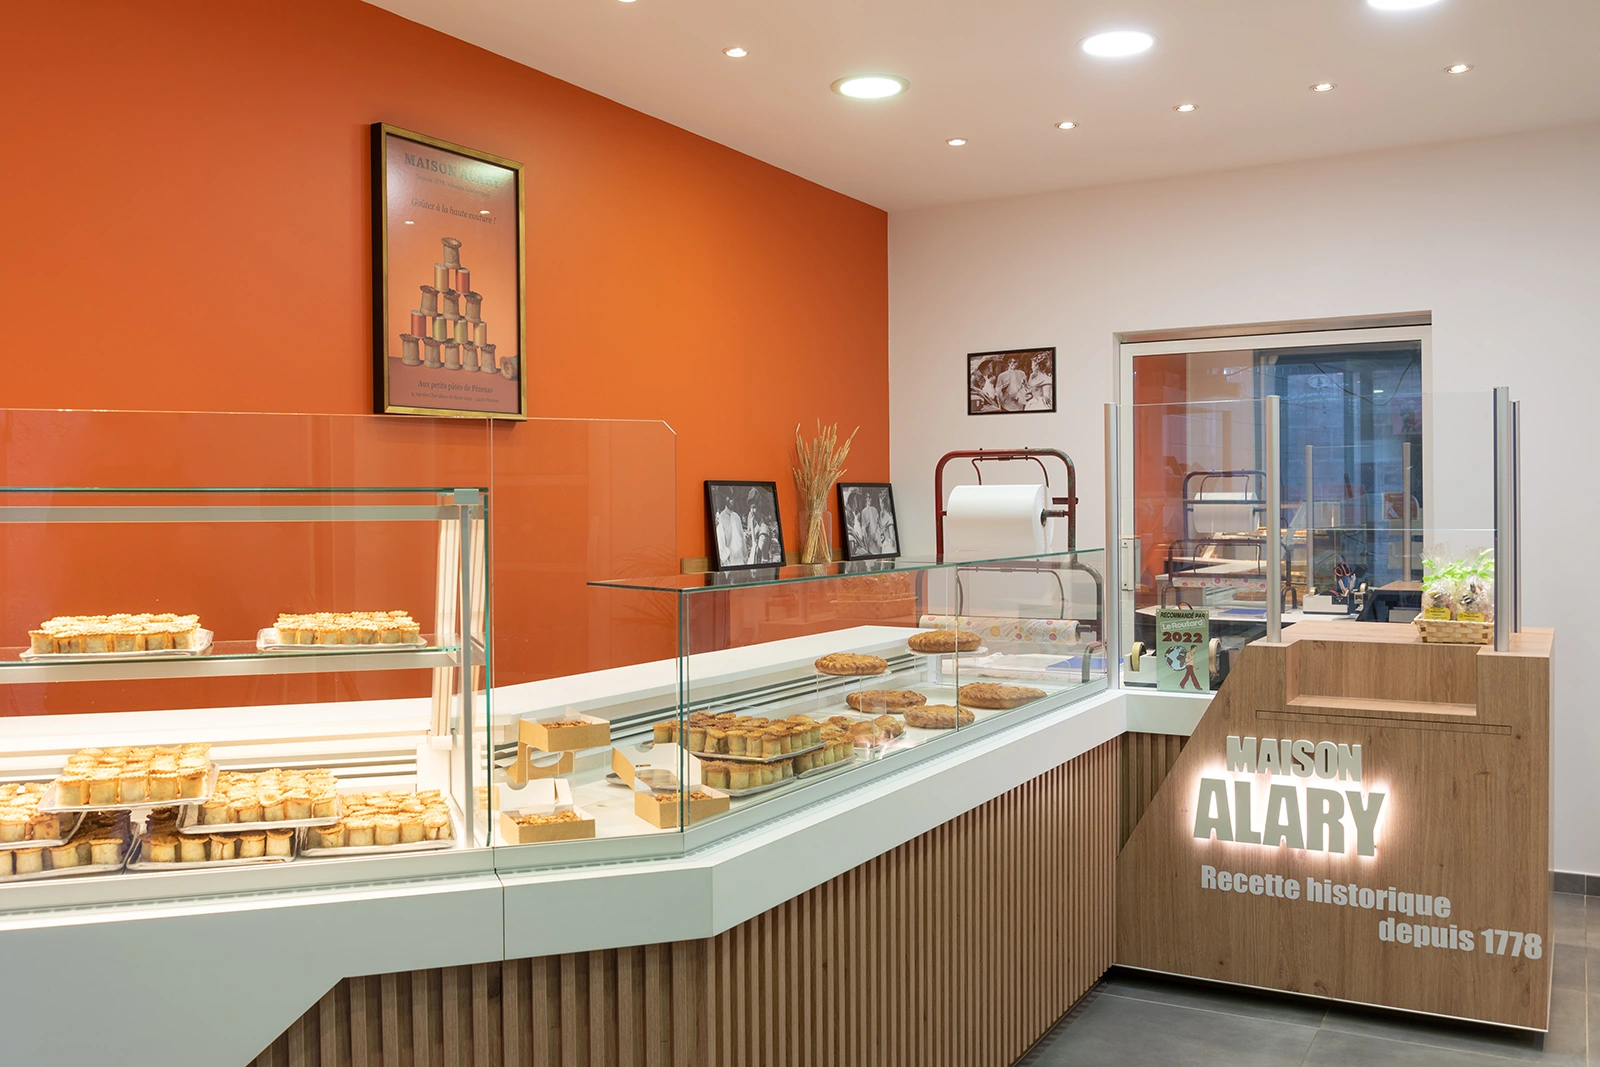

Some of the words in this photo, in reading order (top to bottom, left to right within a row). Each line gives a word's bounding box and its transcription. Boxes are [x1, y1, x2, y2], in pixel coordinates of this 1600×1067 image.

[404, 153, 457, 177] MAISON
[411, 198, 435, 210] Goûtez
[435, 203, 441, 211] à
[441, 205, 449, 213] la
[449, 206, 468, 218] haute
[468, 213, 492, 224] couture
[418, 380, 430, 388] Aux
[430, 382, 447, 390] petits
[448, 382, 463, 391] pâtés
[471, 385, 493, 393] Pézenas
[1162, 631, 1203, 643] 2022
[1171, 619, 1203, 629] Routard
[1226, 735, 1362, 782] MAISON
[1193, 778, 1386, 857] ALARY
[1201, 864, 1300, 900] Recette
[1306, 877, 1451, 919] historique
[1378, 917, 1475, 951] depuis
[1480, 928, 1543, 960] 1778
